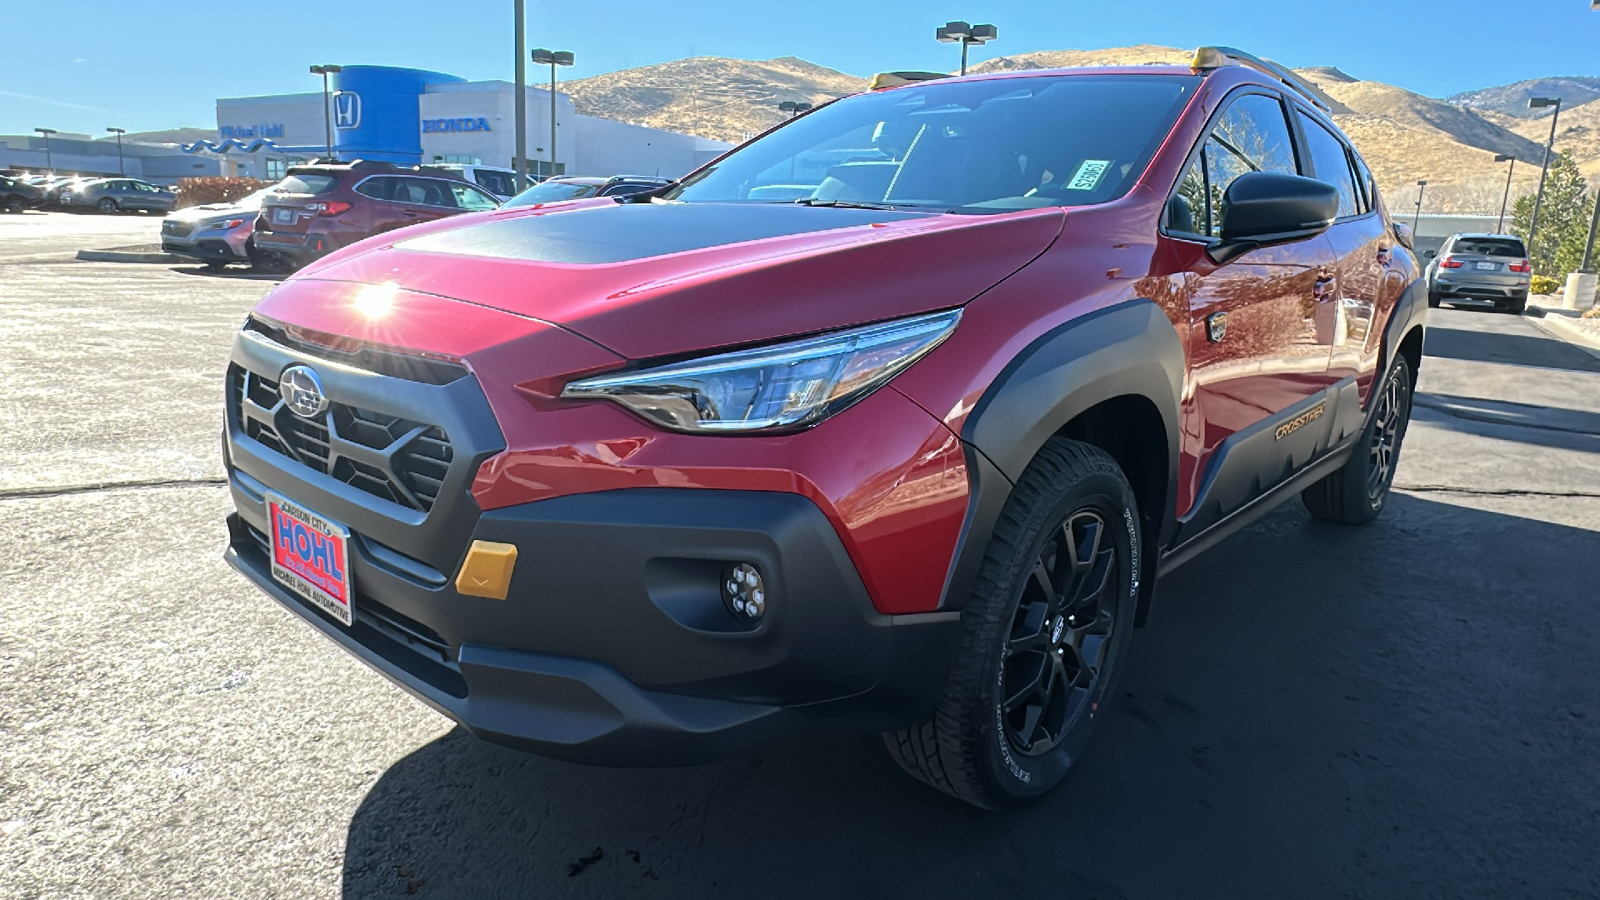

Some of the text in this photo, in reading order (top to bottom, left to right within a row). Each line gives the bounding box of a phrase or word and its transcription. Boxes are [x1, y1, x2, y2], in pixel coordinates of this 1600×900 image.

[422, 117, 492, 133] HONDA
[283, 502, 328, 531] CARSON CITY
[277, 513, 343, 583] HOHL
[273, 566, 349, 621] MICHAEL HOHL AUTOMOTIVE
